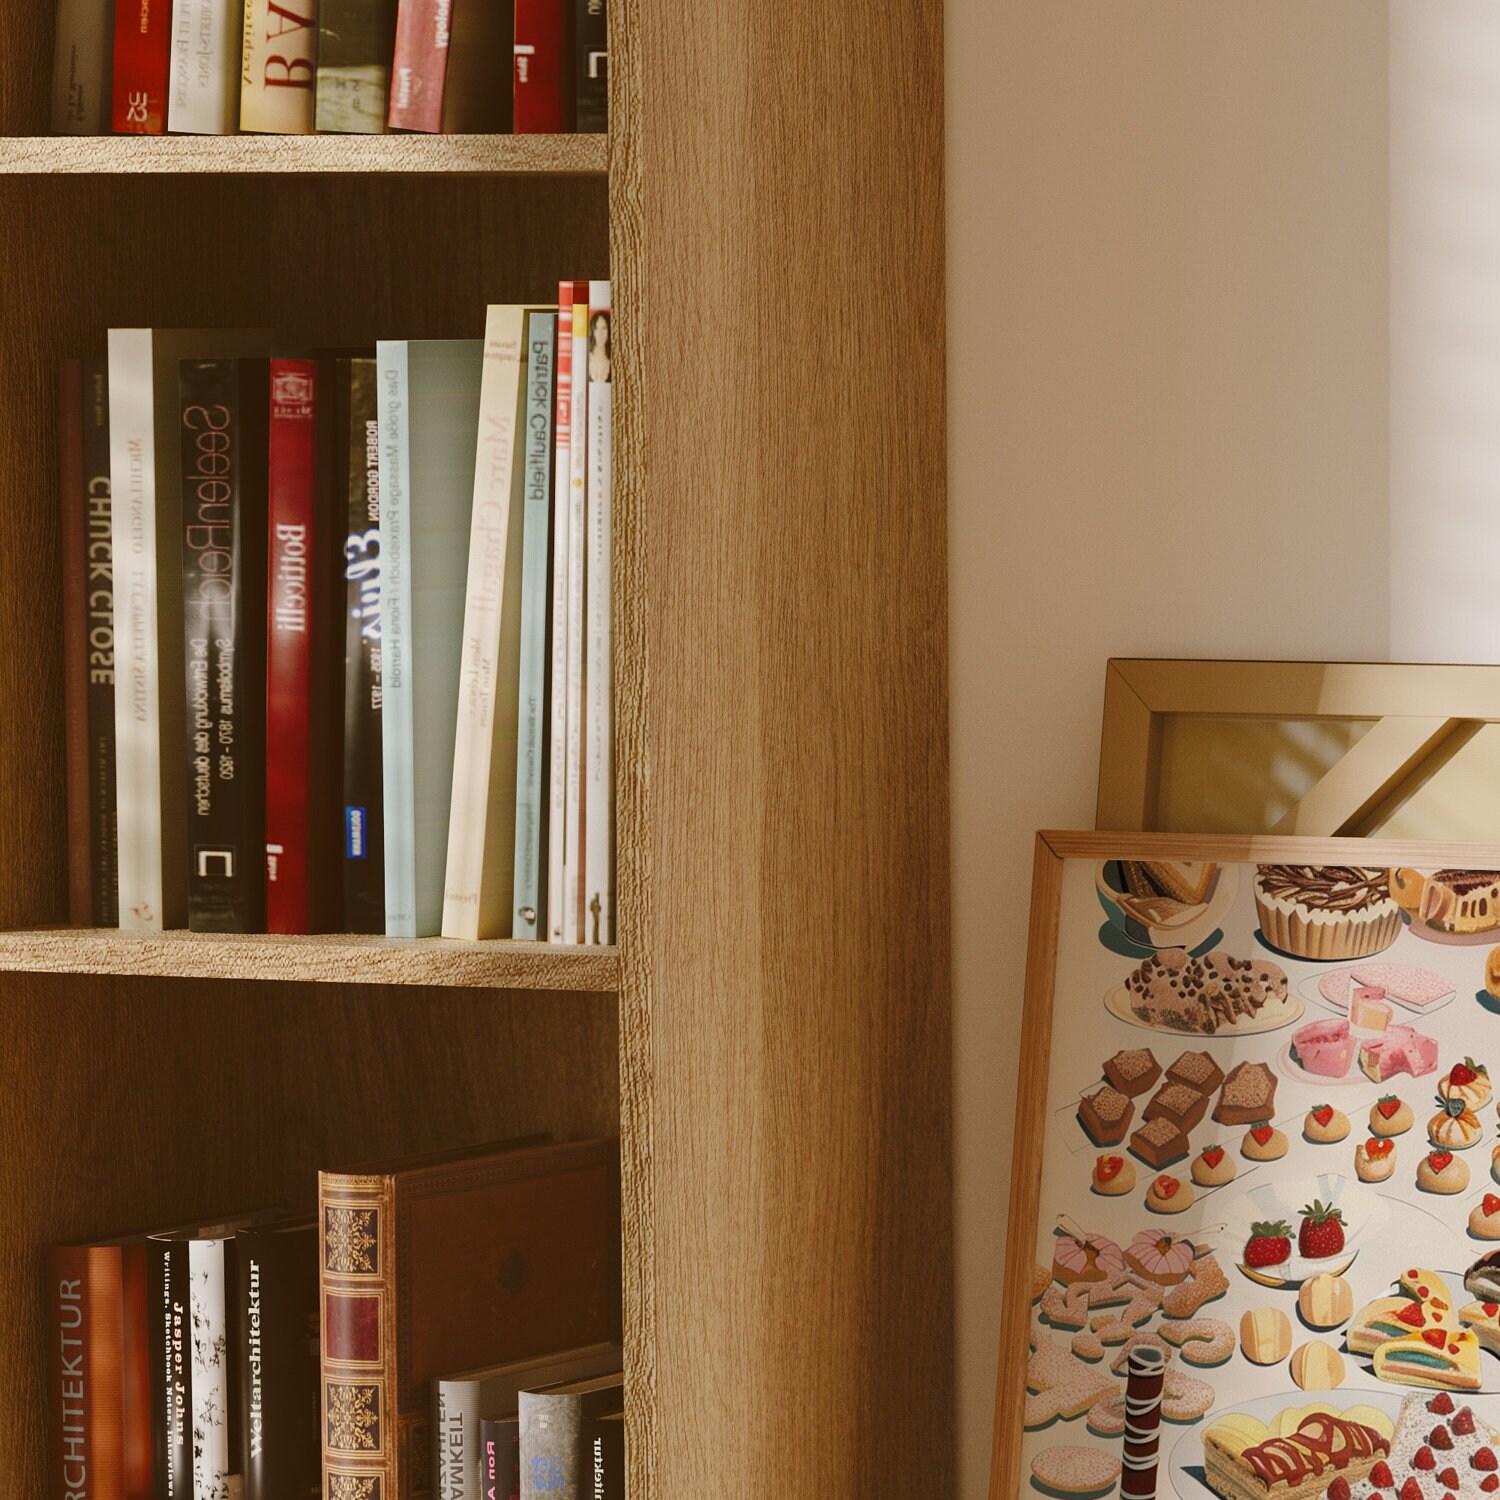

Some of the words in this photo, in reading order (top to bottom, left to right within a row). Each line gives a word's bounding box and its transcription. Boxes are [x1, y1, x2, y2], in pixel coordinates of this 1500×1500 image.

[164, 1312, 173, 1382] Sketchbook
[173, 1301, 186, 1376] Jasper
[247, 1258, 264, 1460] Weltarchitektur
[173, 1380, 186, 1447] Johns
[166, 1429, 174, 1498] Interviews
